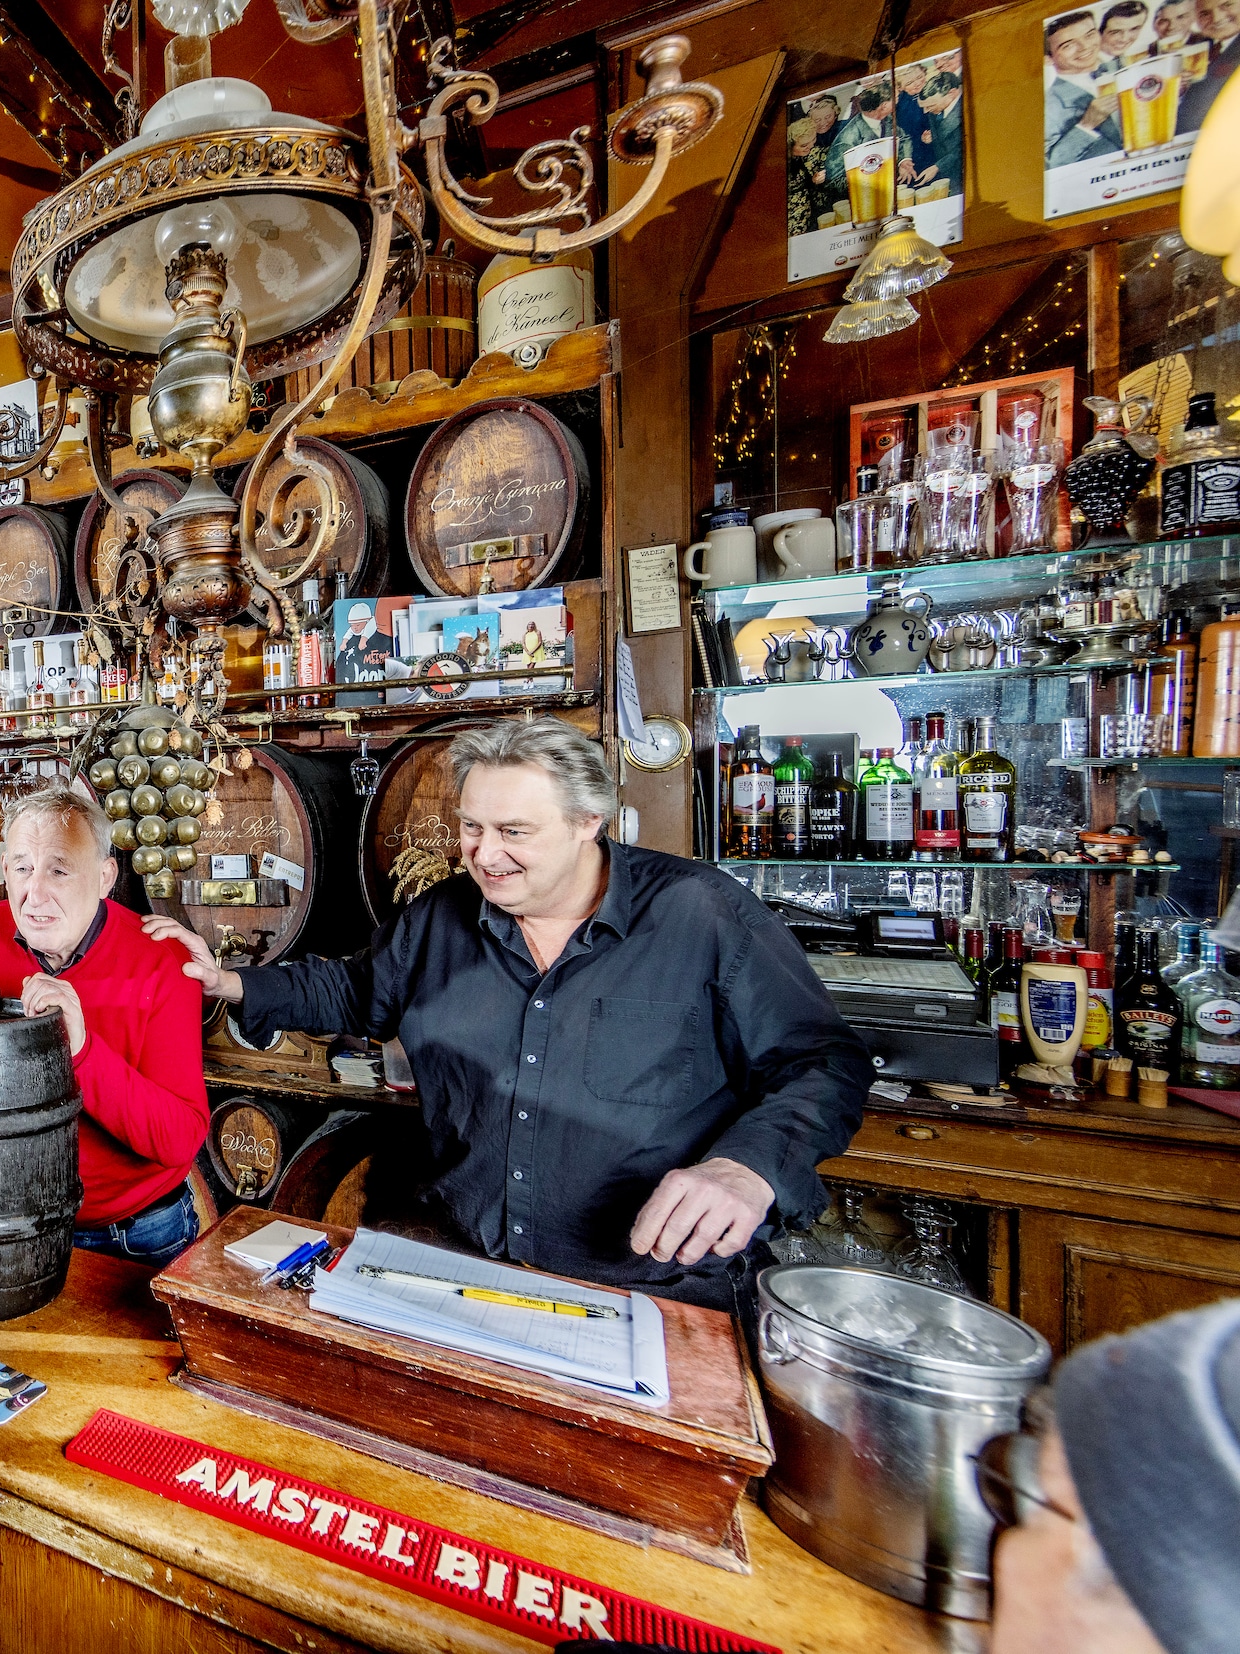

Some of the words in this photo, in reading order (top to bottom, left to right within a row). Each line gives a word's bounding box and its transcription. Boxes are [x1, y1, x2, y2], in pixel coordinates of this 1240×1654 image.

[1090, 176, 1106, 185] ZEG
[1110, 168, 1126, 180] HET
[1130, 163, 1148, 173] MET
[1152, 158, 1170, 168] EEN
[829, 240, 843, 251] ZEG
[844, 237, 857, 248] HET
[858, 233, 874, 245] MET
[431, 487, 495, 526] Oranje
[494, 478, 566, 509] Curaçao
[640, 549, 666, 557] VADER
[304, 640, 313, 685] TROOPWAFEL
[370, 649, 391, 659] Frenk
[420, 652, 461, 677] EYENOORD
[429, 682, 468, 700] ROTTERD
[962, 775, 1008, 784] RICARD
[811, 808, 840, 817] OPKE
[237, 815, 290, 845] Bitter
[278, 866, 303, 881] ENTREPOT
[1124, 1012, 1175, 1024] BAILEYS
[221, 1130, 276, 1168] Wodka
[175, 1457, 416, 1567] AMSTEL
[433, 1541, 616, 1642] BIER
